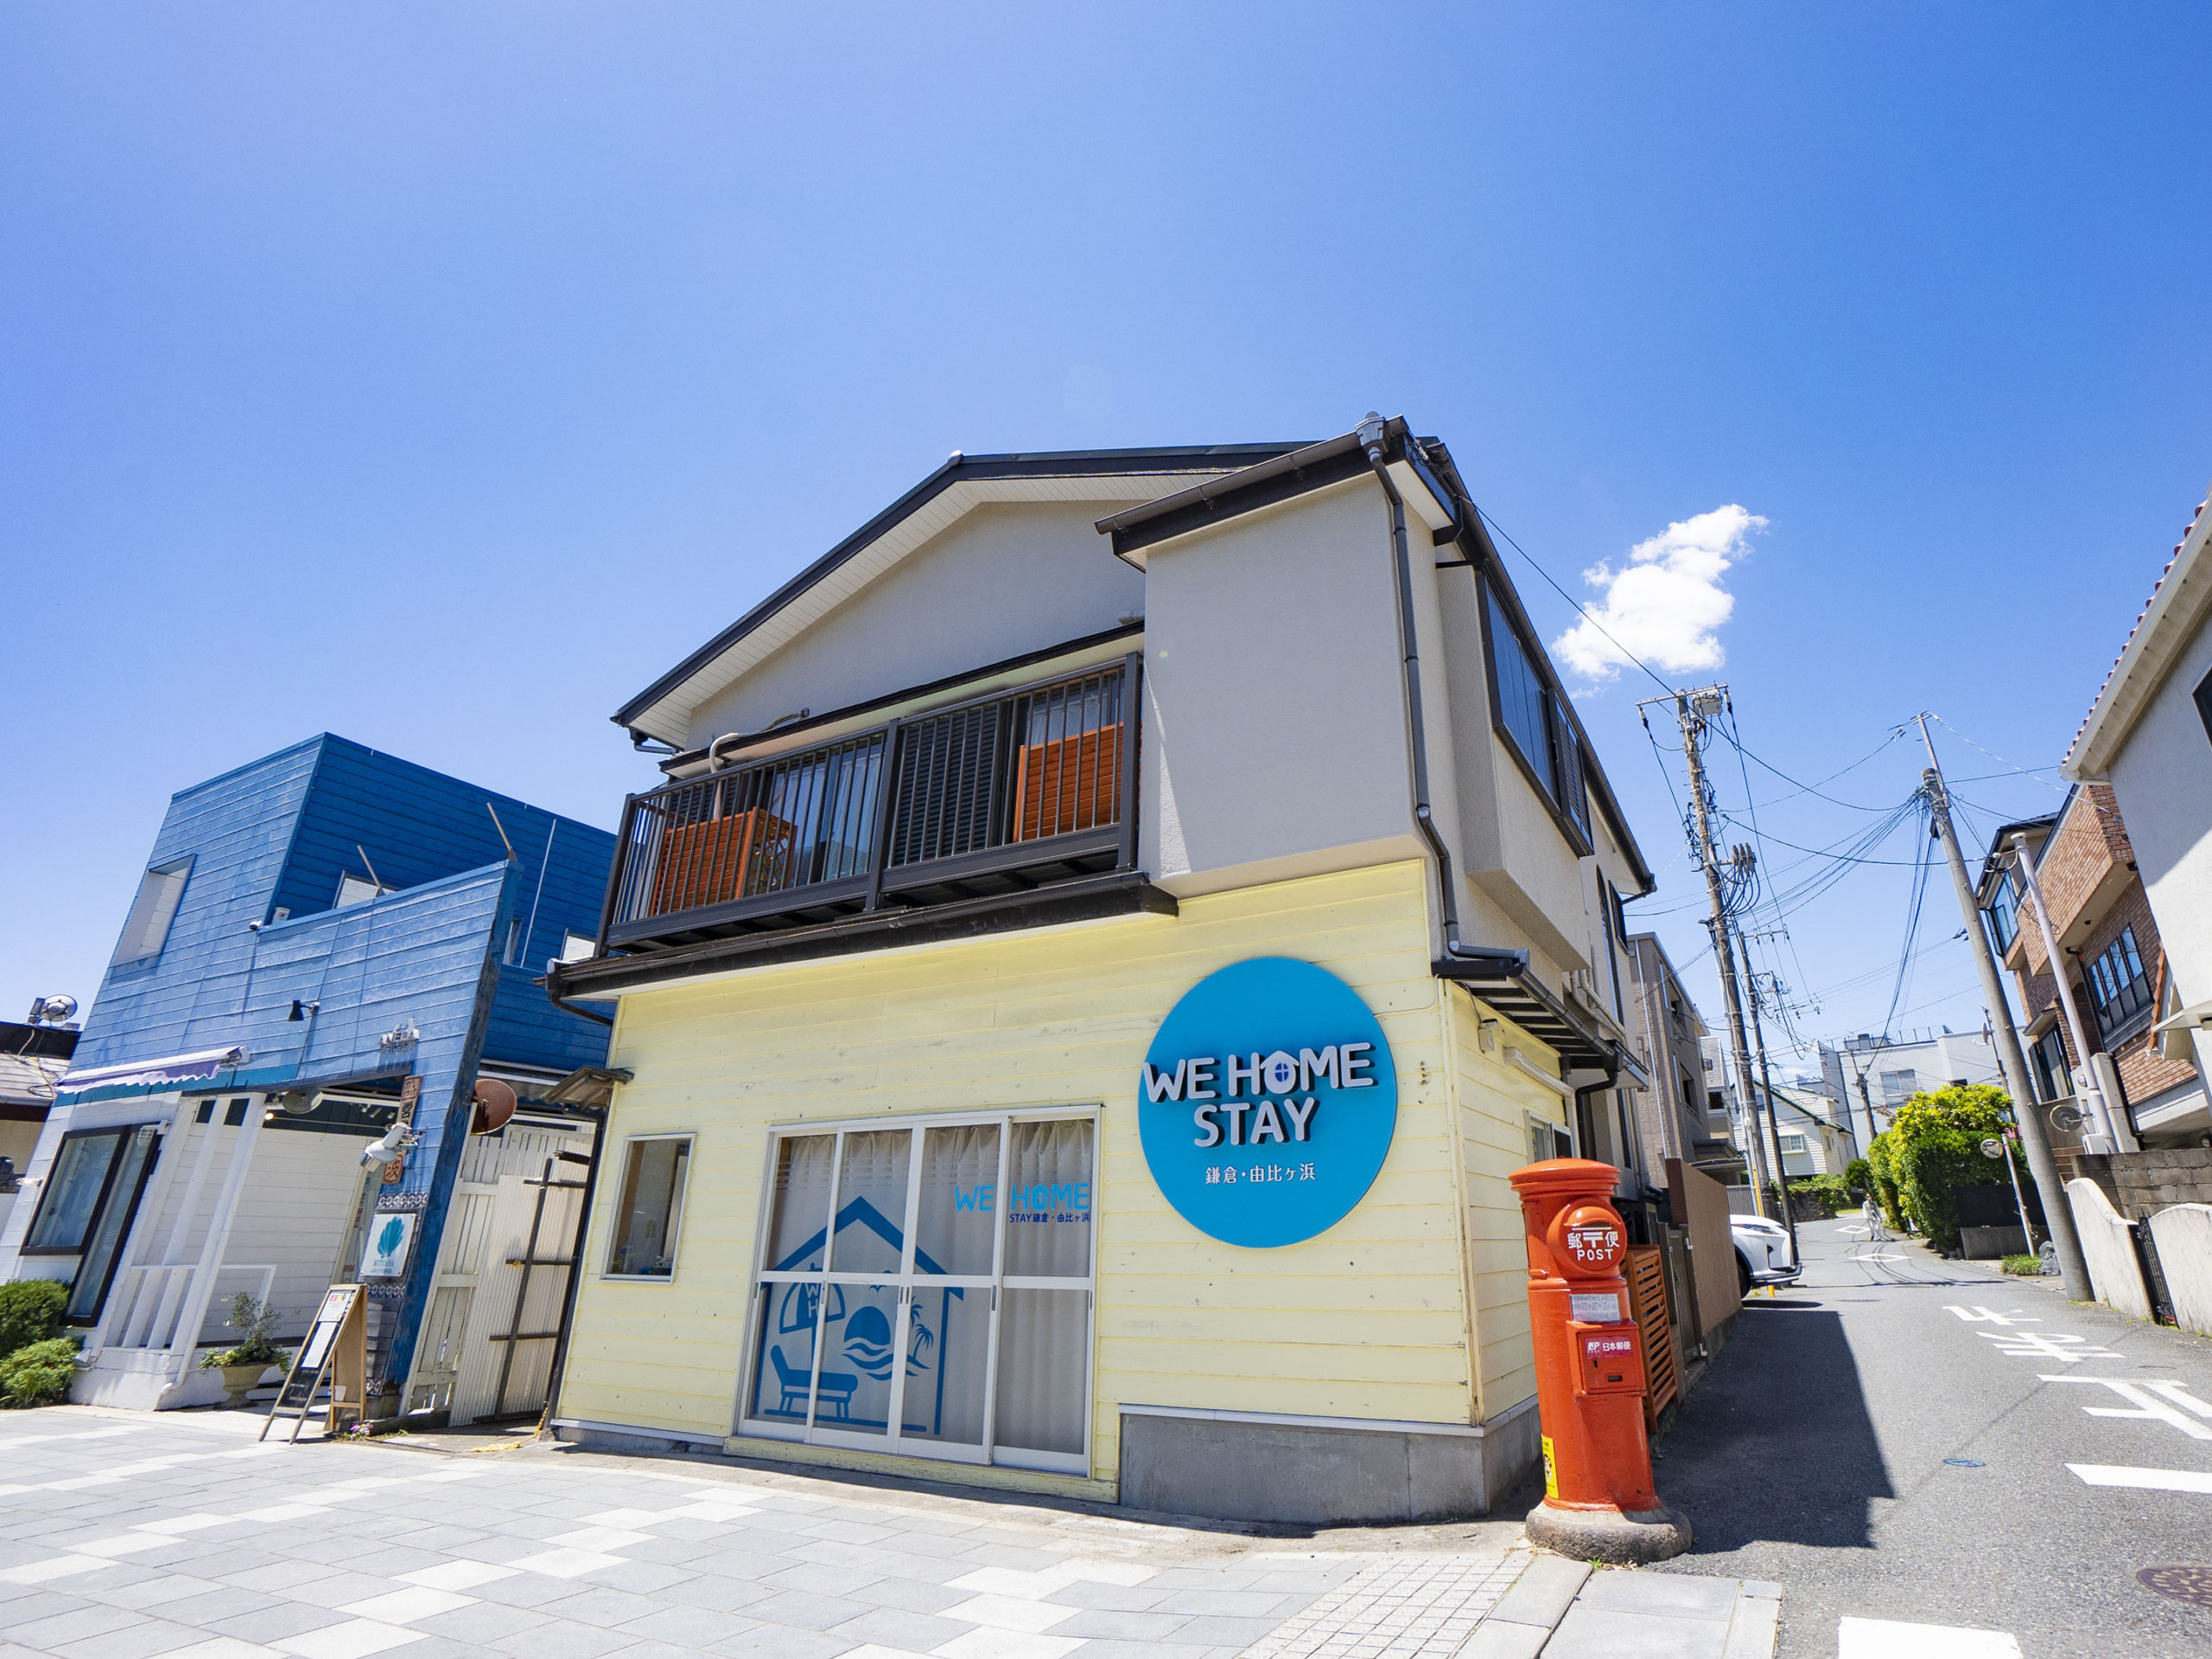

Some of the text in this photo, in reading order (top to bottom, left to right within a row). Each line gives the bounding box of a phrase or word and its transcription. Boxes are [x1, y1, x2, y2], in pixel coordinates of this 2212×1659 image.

[1142, 1042, 1375, 1103] WE HOME
[1193, 1096, 1316, 1148] STAY
[954, 1182, 1091, 1212] WE HOME
[1576, 1248, 1614, 1262] POST
[1602, 1340, 1631, 1351] 日本郵便
